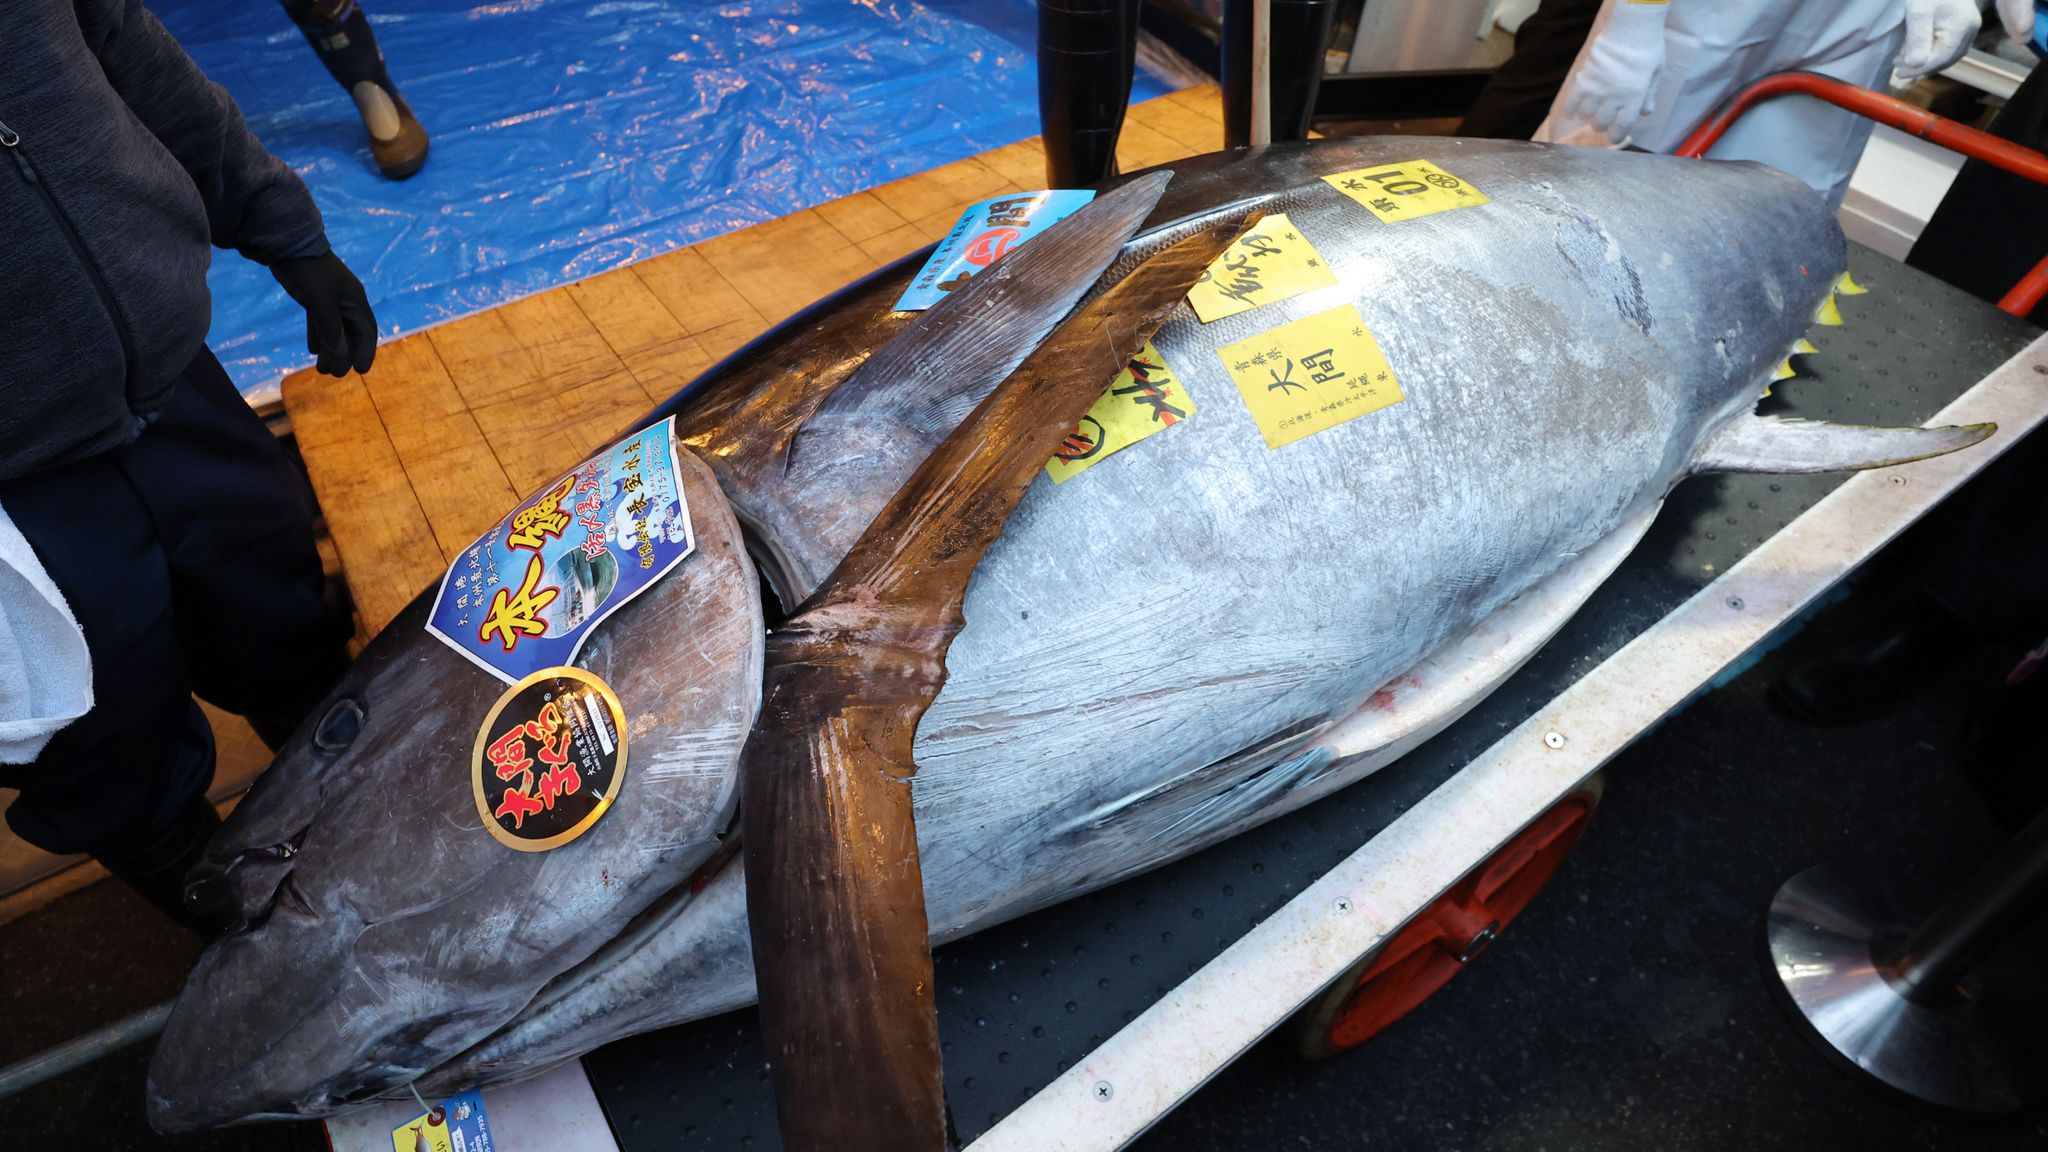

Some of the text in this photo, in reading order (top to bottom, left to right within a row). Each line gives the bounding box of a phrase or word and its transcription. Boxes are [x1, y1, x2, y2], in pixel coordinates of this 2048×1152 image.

[1363, 170, 1429, 196] 01
[1234, 347, 1283, 373] 青森県
[1267, 348, 1346, 396] 大間
[487, 724, 543, 830] 大間
[524, 702, 581, 810] まぐろ
